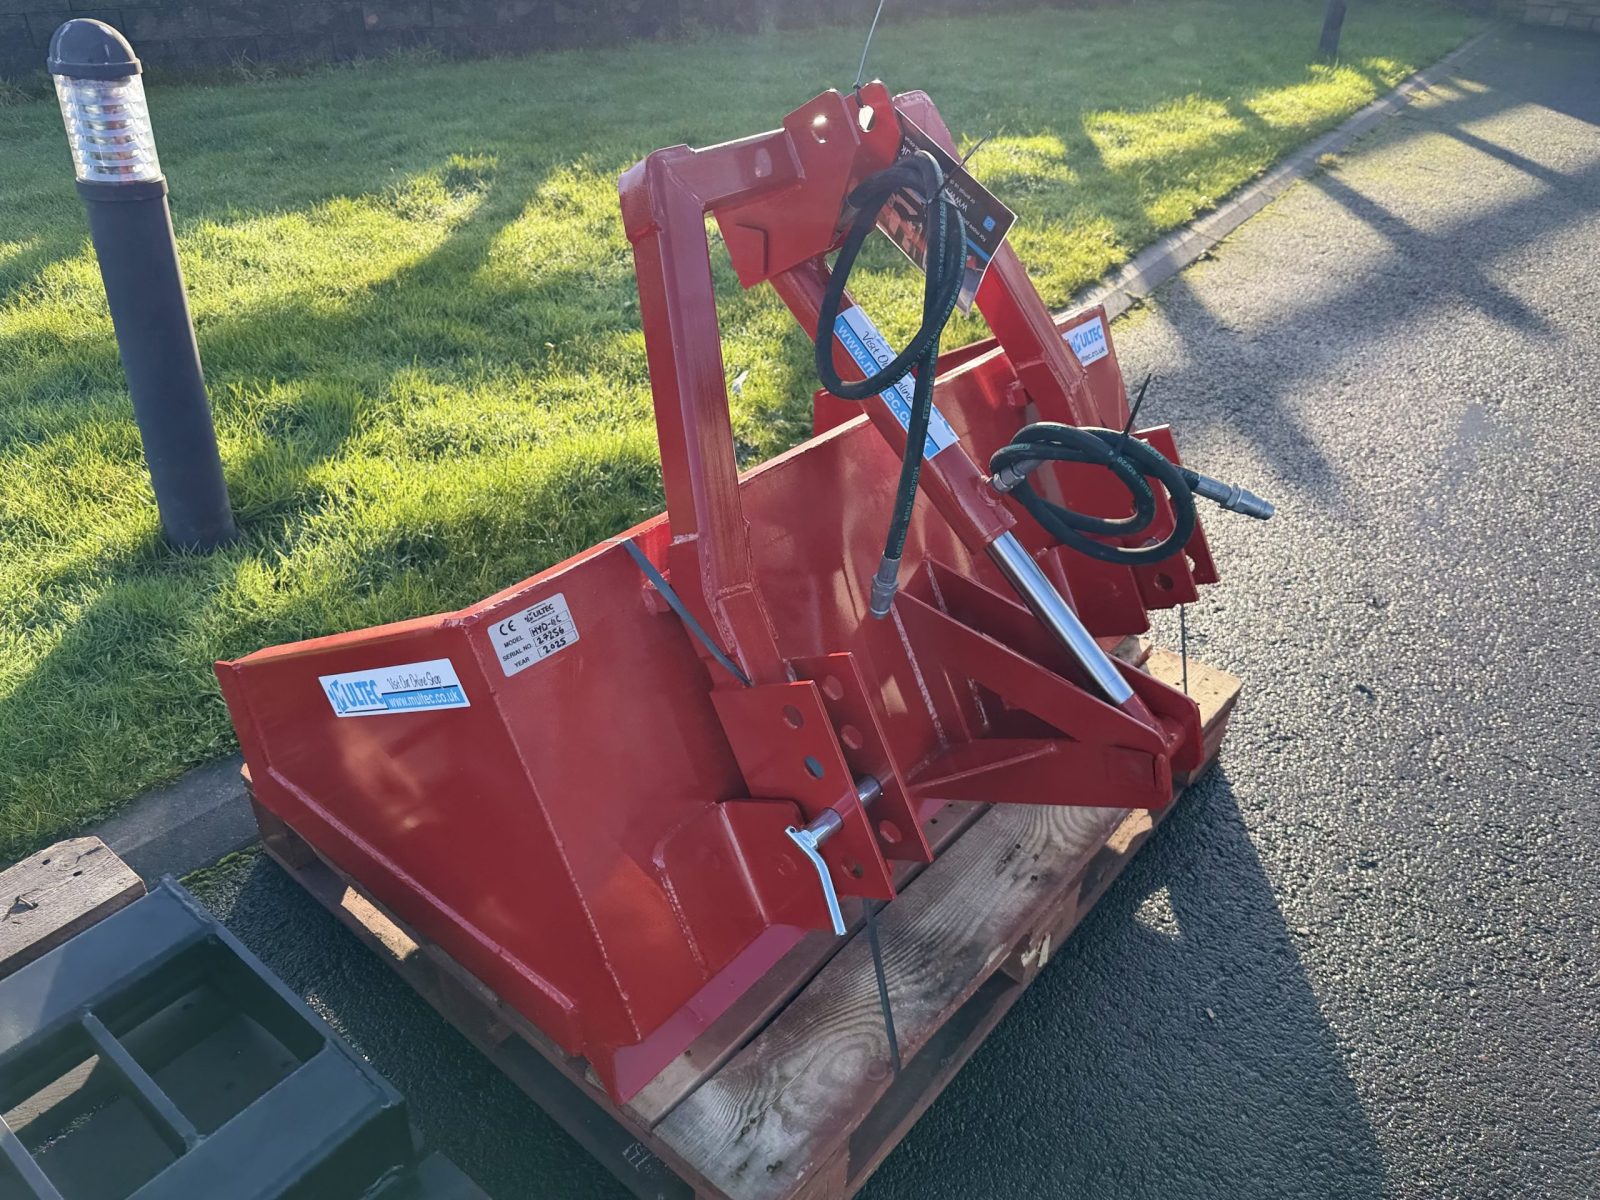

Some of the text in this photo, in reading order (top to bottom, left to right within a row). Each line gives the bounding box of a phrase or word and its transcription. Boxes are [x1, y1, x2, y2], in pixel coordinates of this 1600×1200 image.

[862, 330, 880, 357] Visit
[895, 379, 913, 402] nline
[503, 635, 524, 648] MODEL
[542, 636, 567, 654] 2025
[502, 643, 532, 662] SERIAL NO
[514, 656, 531, 668] YEAR
[386, 671, 442, 690] Visit Our Online Shop
[328, 679, 385, 713] MULTEC
[388, 690, 461, 708] www.multec.co.uk
